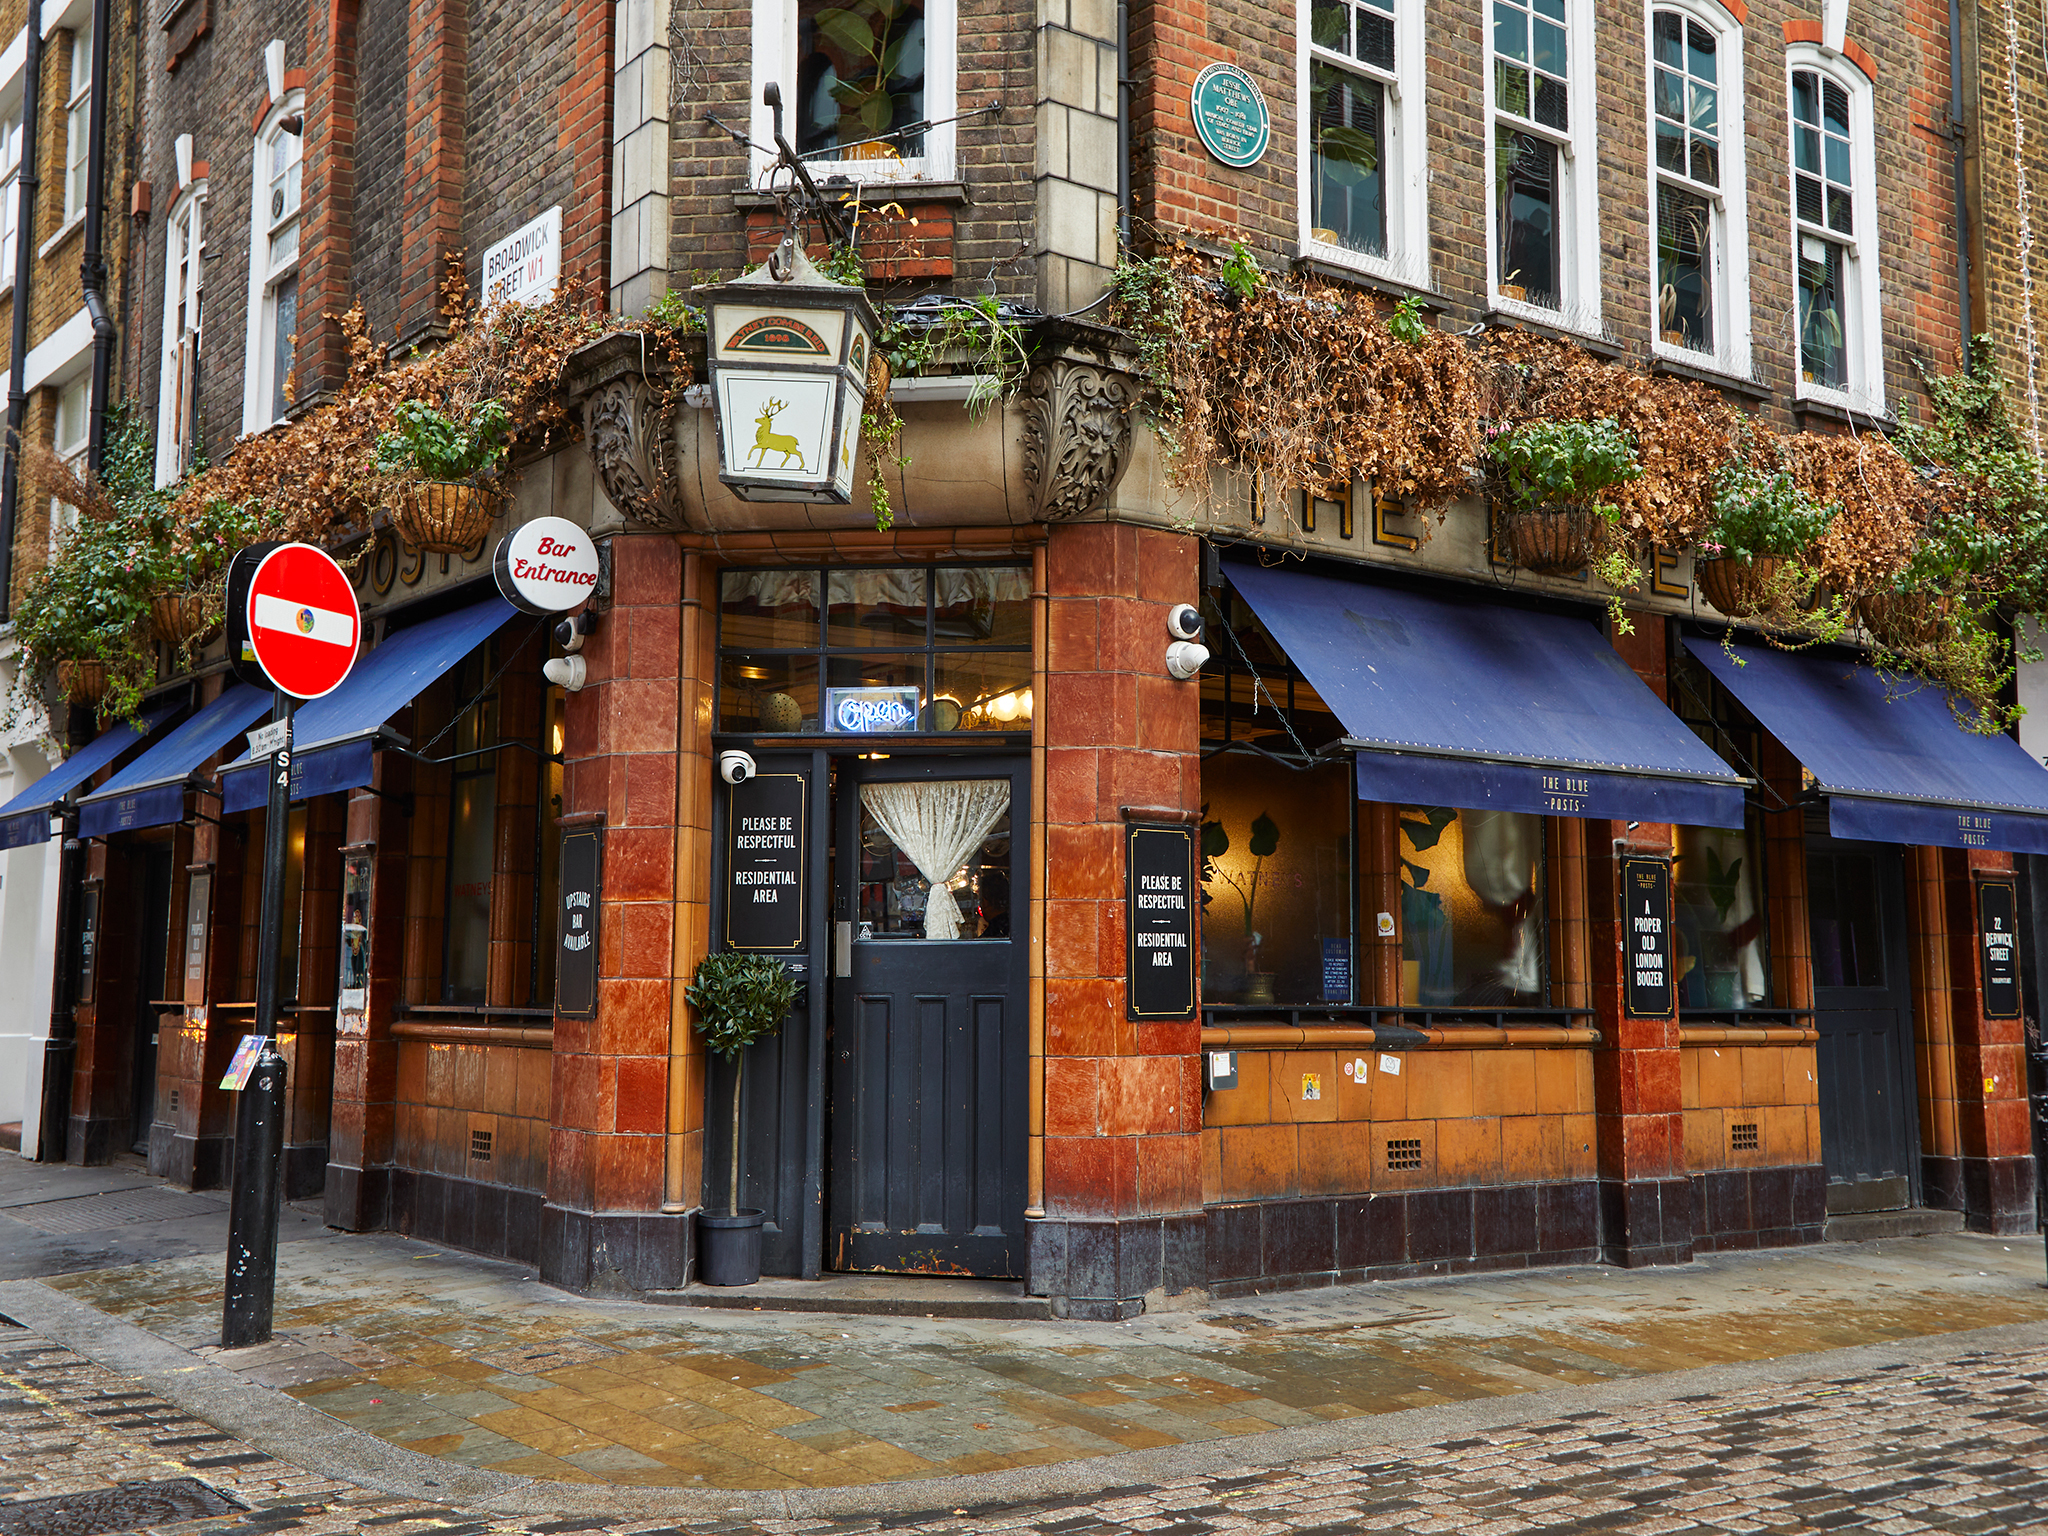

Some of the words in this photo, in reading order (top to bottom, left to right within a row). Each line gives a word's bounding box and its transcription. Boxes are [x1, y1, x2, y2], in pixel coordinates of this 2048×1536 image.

[1221, 79, 1241, 91] JESSIE
[1212, 84, 1250, 104] MATTHEWS
[1224, 97, 1238, 108] OBE
[1226, 132, 1240, 141] BORN
[488, 222, 549, 279] BROADWICK
[528, 254, 543, 283] W1
[727, 318, 767, 348] WATNEY
[768, 318, 806, 333] COMBE
[805, 327, 825, 352] REID
[765, 334, 790, 343] 1898
[537, 536, 577, 558] Bar
[513, 558, 597, 586] Entrance
[838, 698, 911, 732] Open
[1543, 776, 1559, 790] THE
[1566, 778, 1588, 792] BLUE
[742, 817, 776, 831] PLEASE
[780, 817, 792, 830] BE
[1958, 816, 1970, 827] THE
[1975, 817, 1991, 829] BLUE
[737, 835, 796, 849] RESPECTFUL
[736, 871, 796, 885] RESIDENTIAL
[1141, 876, 1170, 890] PLEASE
[1172, 876, 1182, 890] BE
[565, 891, 591, 910] UPSTAIRS
[753, 889, 778, 903] AREA
[1138, 895, 1186, 910] RESPECTFUL
[1645, 900, 1650, 915] A
[572, 914, 583, 929] BAR
[1634, 918, 1662, 933] PROPER
[1994, 917, 2002, 930] 22
[563, 930, 591, 952] AVAILABLE
[1138, 933, 1187, 947] RESIDENTIAL
[1642, 935, 1656, 951] OLD
[1985, 932, 2013, 948] BERWICK
[1152, 952, 1172, 966] AREA
[1635, 954, 1663, 969] LONDON
[1990, 948, 2009, 961] STREET
[1637, 971, 1663, 987] BOOZER
